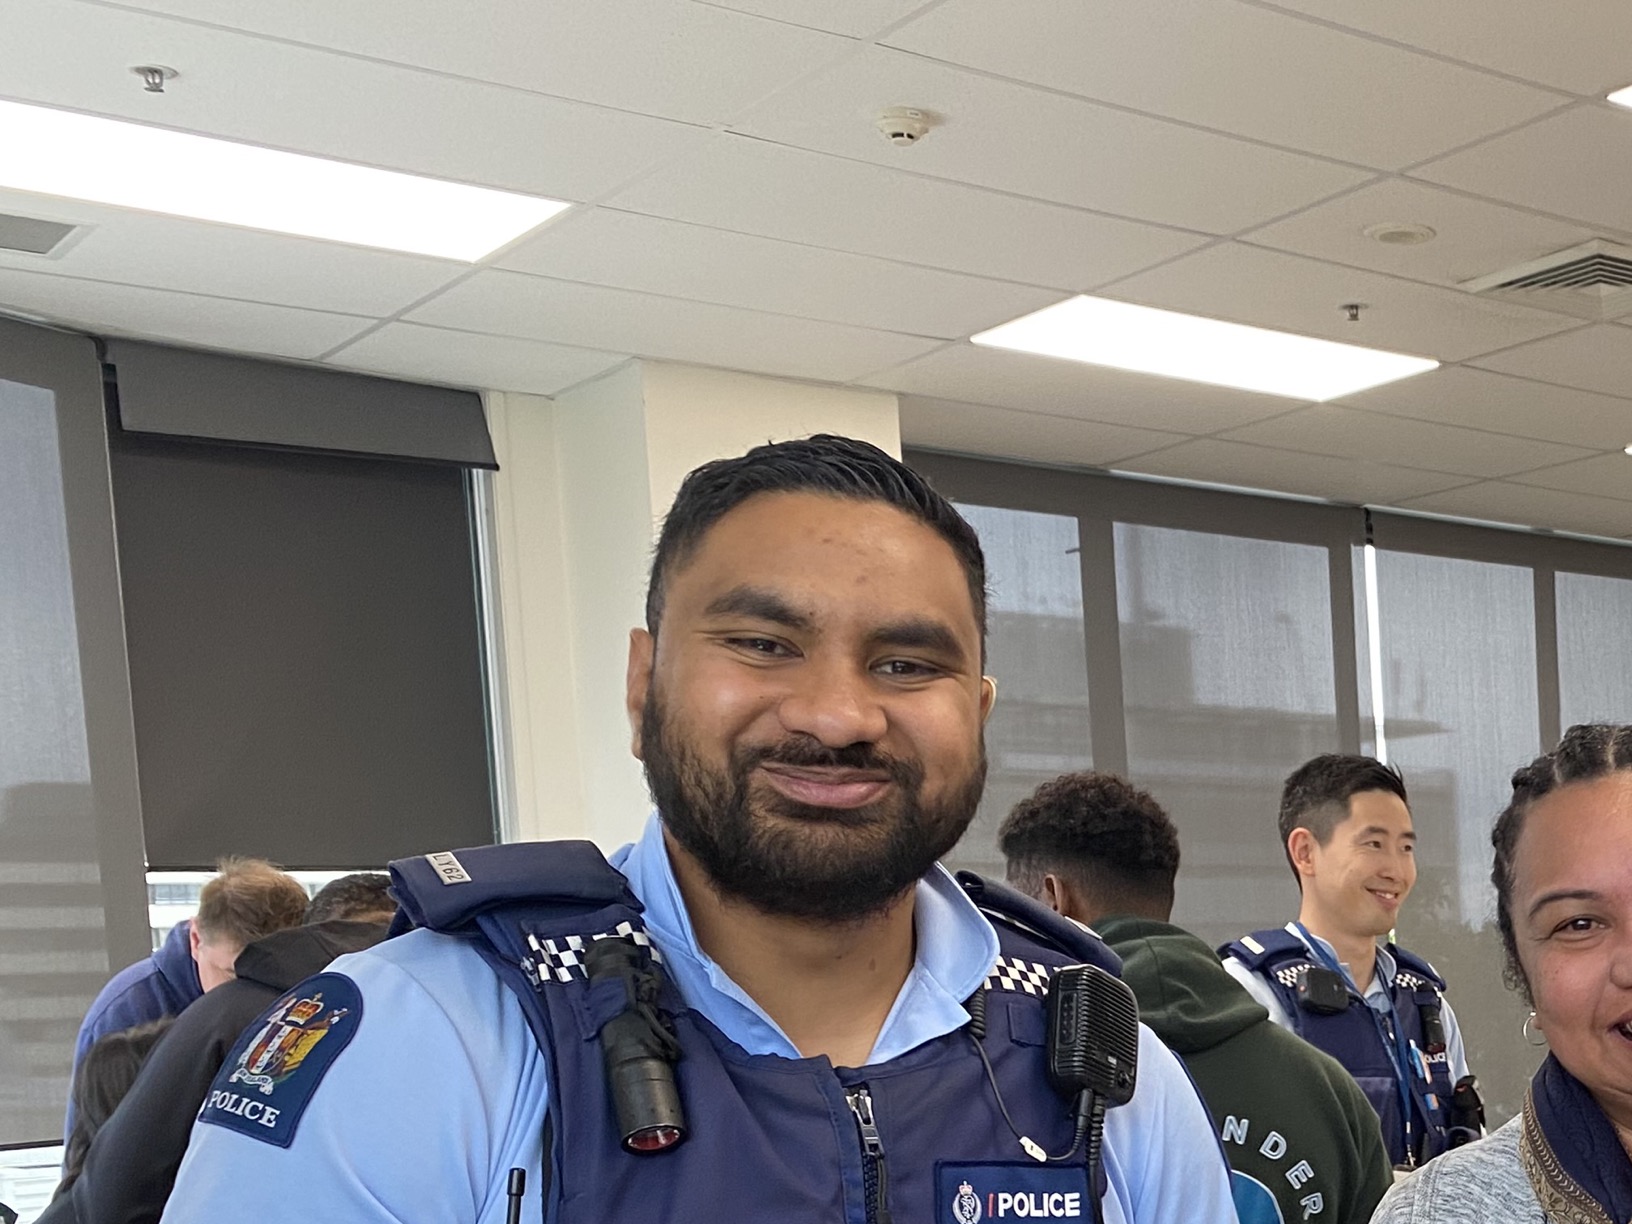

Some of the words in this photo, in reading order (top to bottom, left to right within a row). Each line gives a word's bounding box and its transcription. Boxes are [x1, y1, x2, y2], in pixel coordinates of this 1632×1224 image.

[207, 1090, 281, 1128] POLICE
[1221, 1115, 1324, 1220] NDER
[998, 1192, 1081, 1218] POLICE
